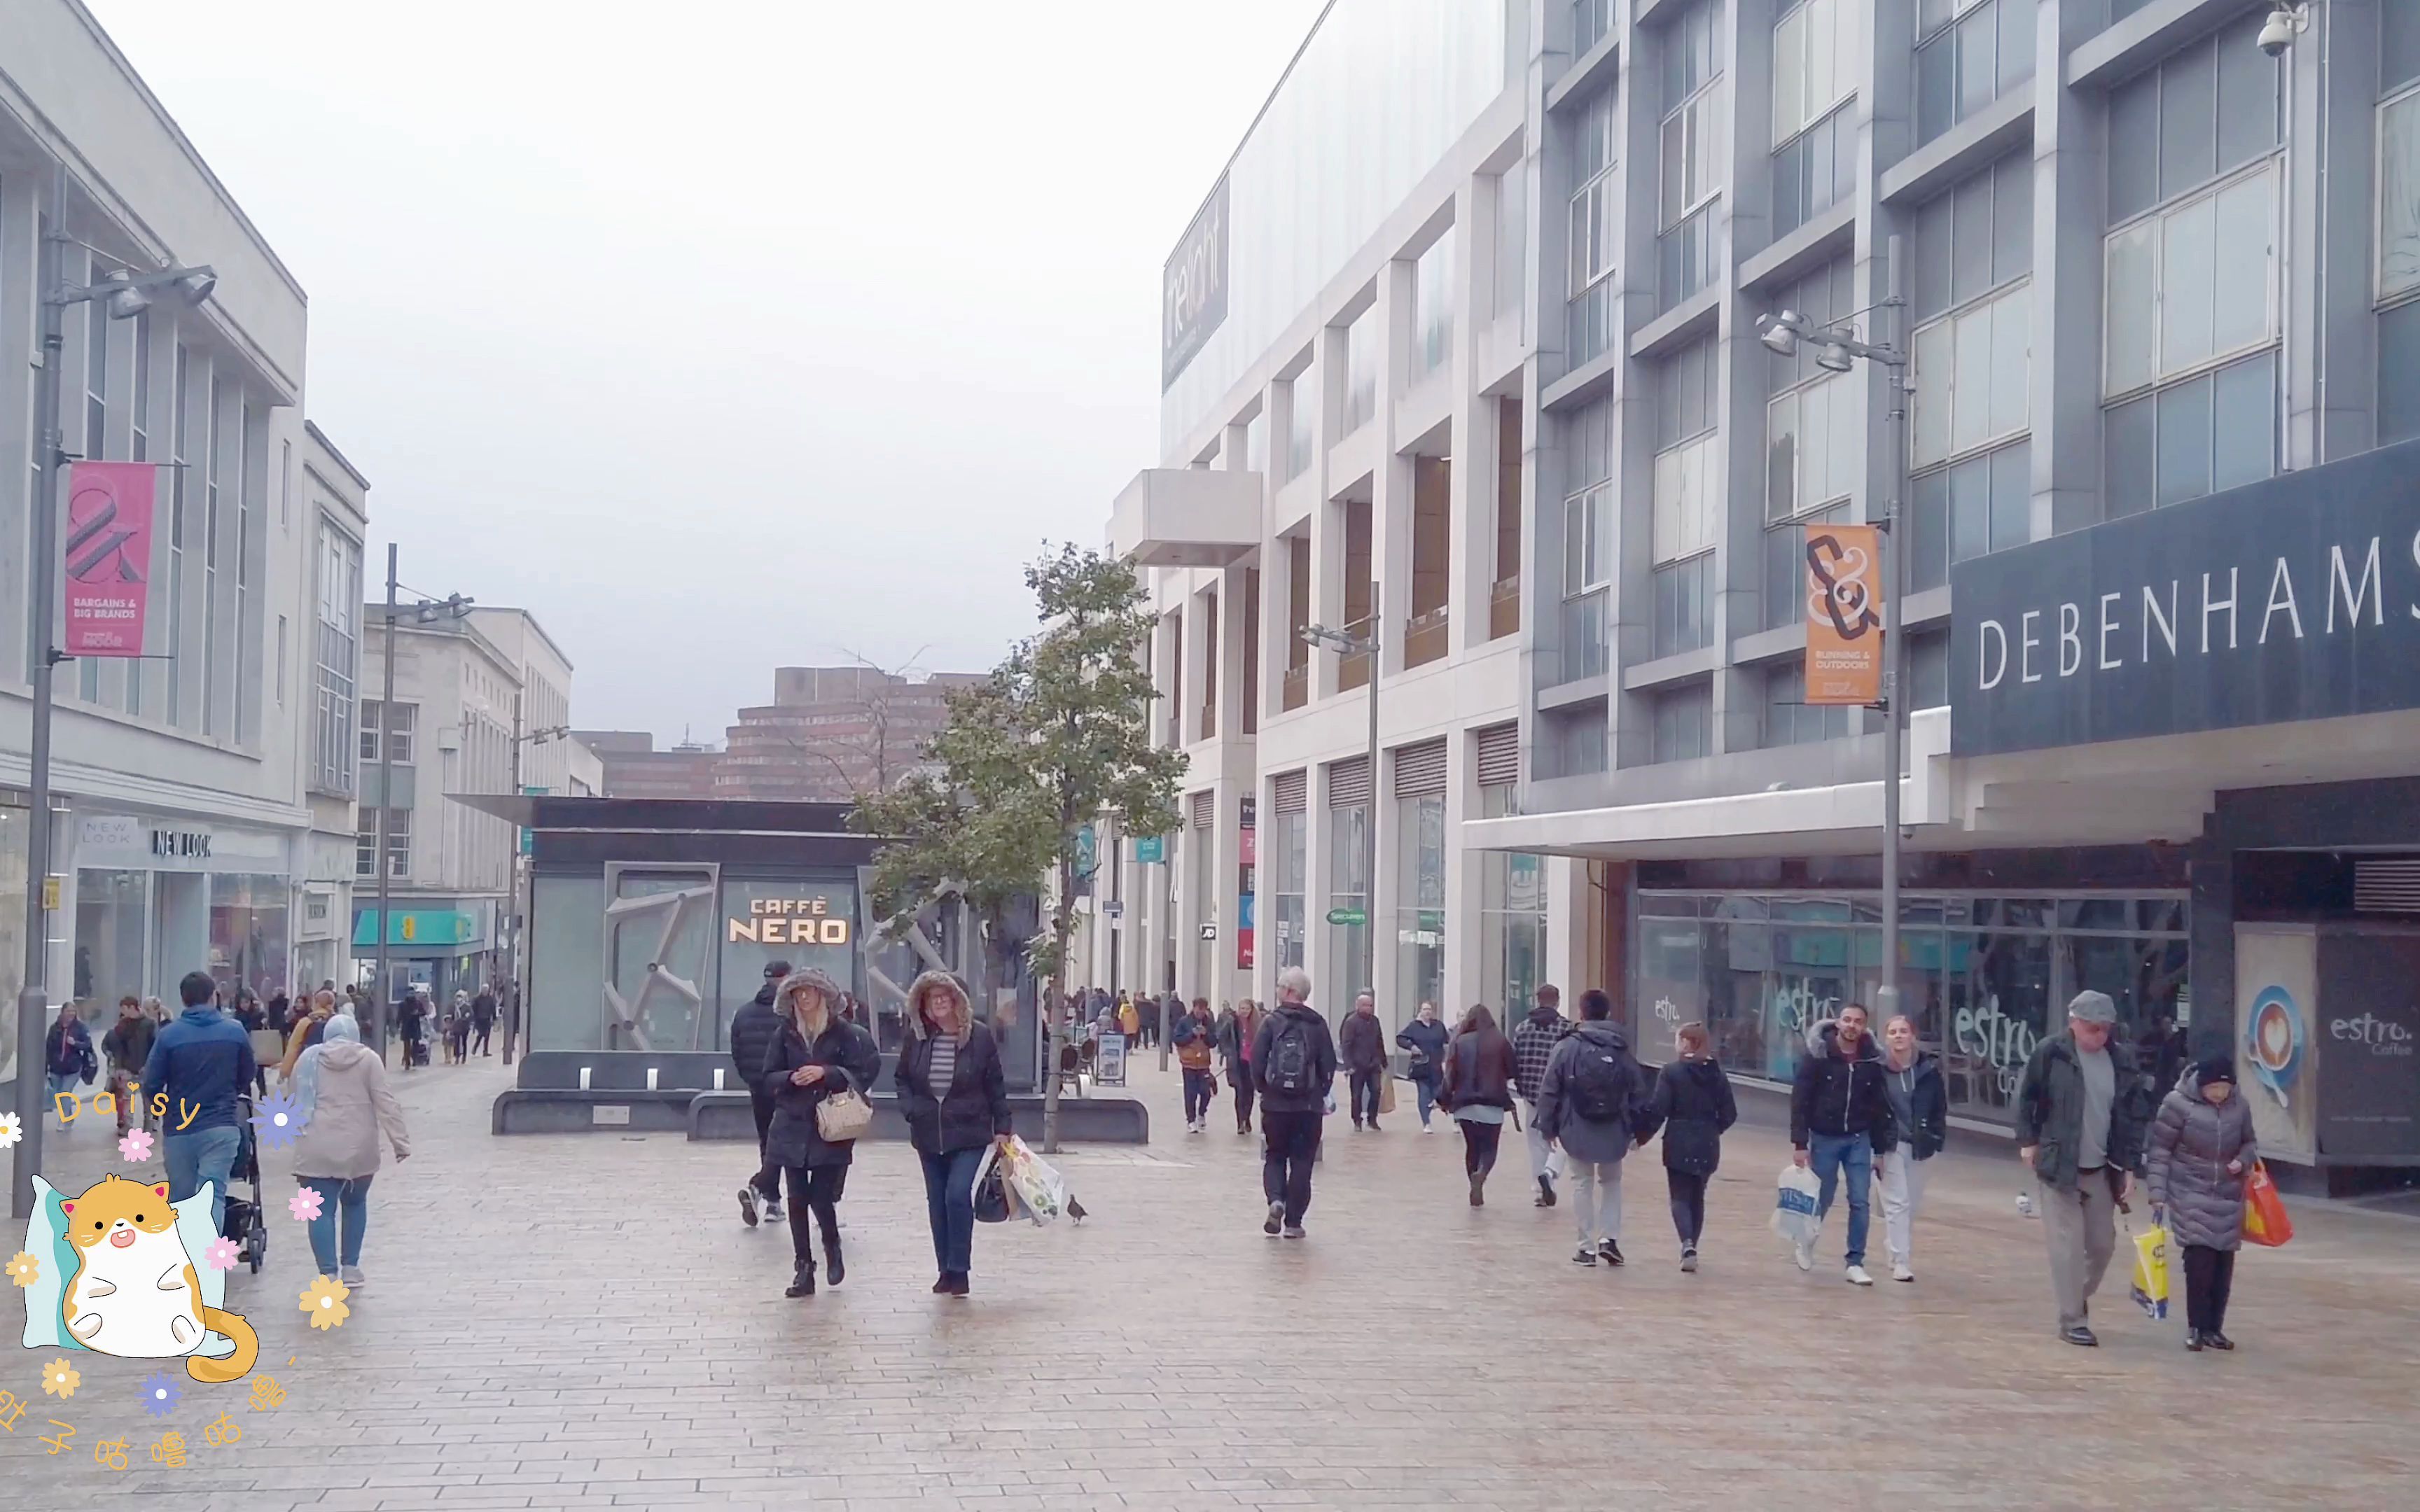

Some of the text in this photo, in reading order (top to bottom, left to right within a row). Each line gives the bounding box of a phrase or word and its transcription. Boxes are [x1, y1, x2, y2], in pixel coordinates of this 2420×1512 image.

[74, 597, 136, 608] BARGAINS &
[74, 608, 135, 618] BIG BRANDS
[1980, 530, 2420, 690] DEBENHAM
[1816, 660, 1869, 669] OUTDOORS
[86, 822, 128, 832] NEW
[83, 834, 130, 844] LOOK
[154, 830, 212, 857] NEW LOOK
[750, 895, 826, 915] CAFFÈ
[729, 918, 847, 944] NERO
[2372, 1043, 2413, 1056] Coffee
